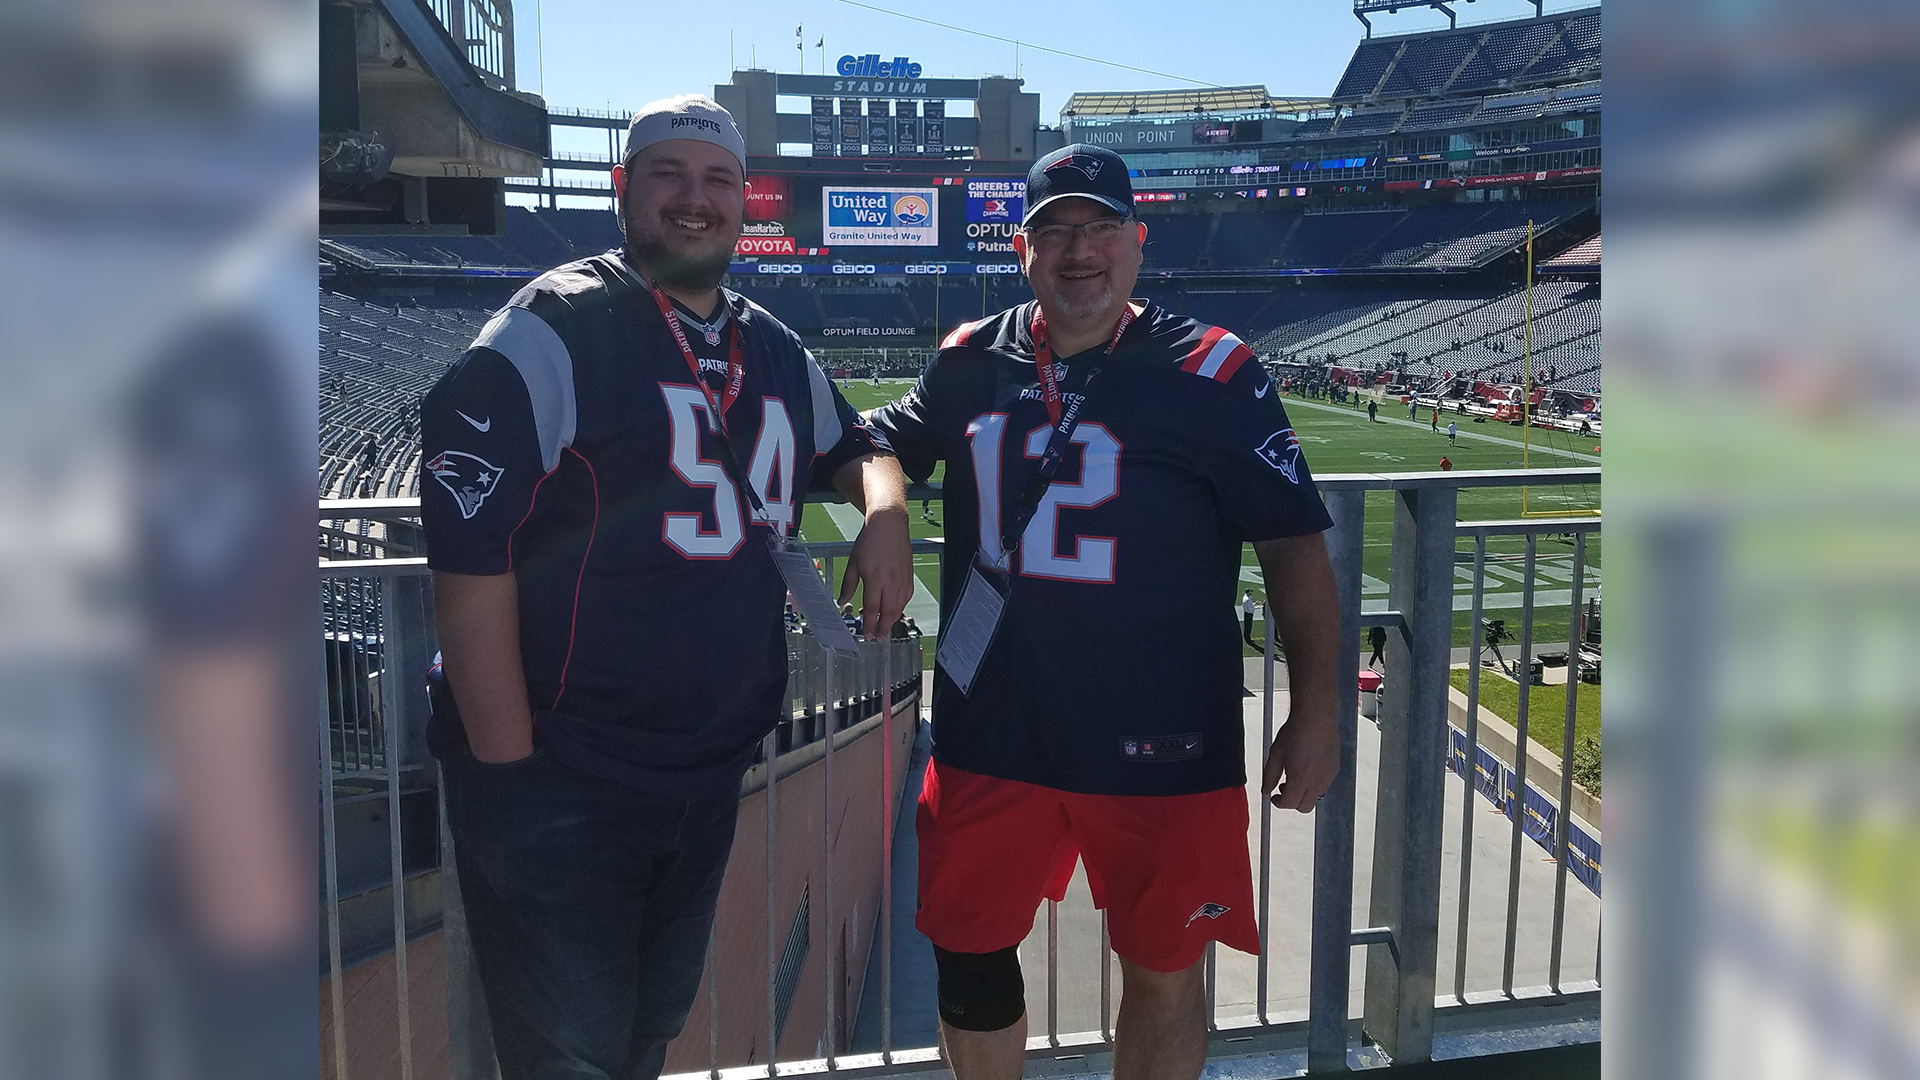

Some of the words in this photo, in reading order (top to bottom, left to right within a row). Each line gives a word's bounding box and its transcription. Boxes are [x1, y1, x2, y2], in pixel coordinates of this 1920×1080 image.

[836, 53, 923, 79] Gillette
[833, 81, 927, 94] STADIUM
[671, 117, 721, 134] PATRIOTS
[1085, 132, 1123, 144] UNION
[1137, 130, 1175, 143] POINT
[968, 182, 1010, 191] CHEERS
[1011, 182, 1026, 191] TO
[831, 195, 888, 209] United
[853, 209, 887, 225] Way
[829, 231, 864, 240] Granite
[867, 232, 899, 240] United
[901, 232, 922, 241] Way
[734, 240, 794, 252] TOYOTA
[758, 264, 803, 274] GEICO
[832, 264, 876, 274] GEICO
[905, 265, 948, 274] GEICO
[976, 264, 1018, 274] GEICO
[665, 311, 692, 353] PATRIOTS
[823, 327, 854, 336] OPTUM
[856, 327, 879, 336] FIELD
[881, 327, 916, 336] LOUNGE
[728, 363, 743, 397] PATRIOTS
[1042, 364, 1058, 402] PATRIOTS
[1058, 394, 1086, 434] PATRIOTS
[657, 381, 796, 561] 54
[965, 411, 1124, 584] 12
